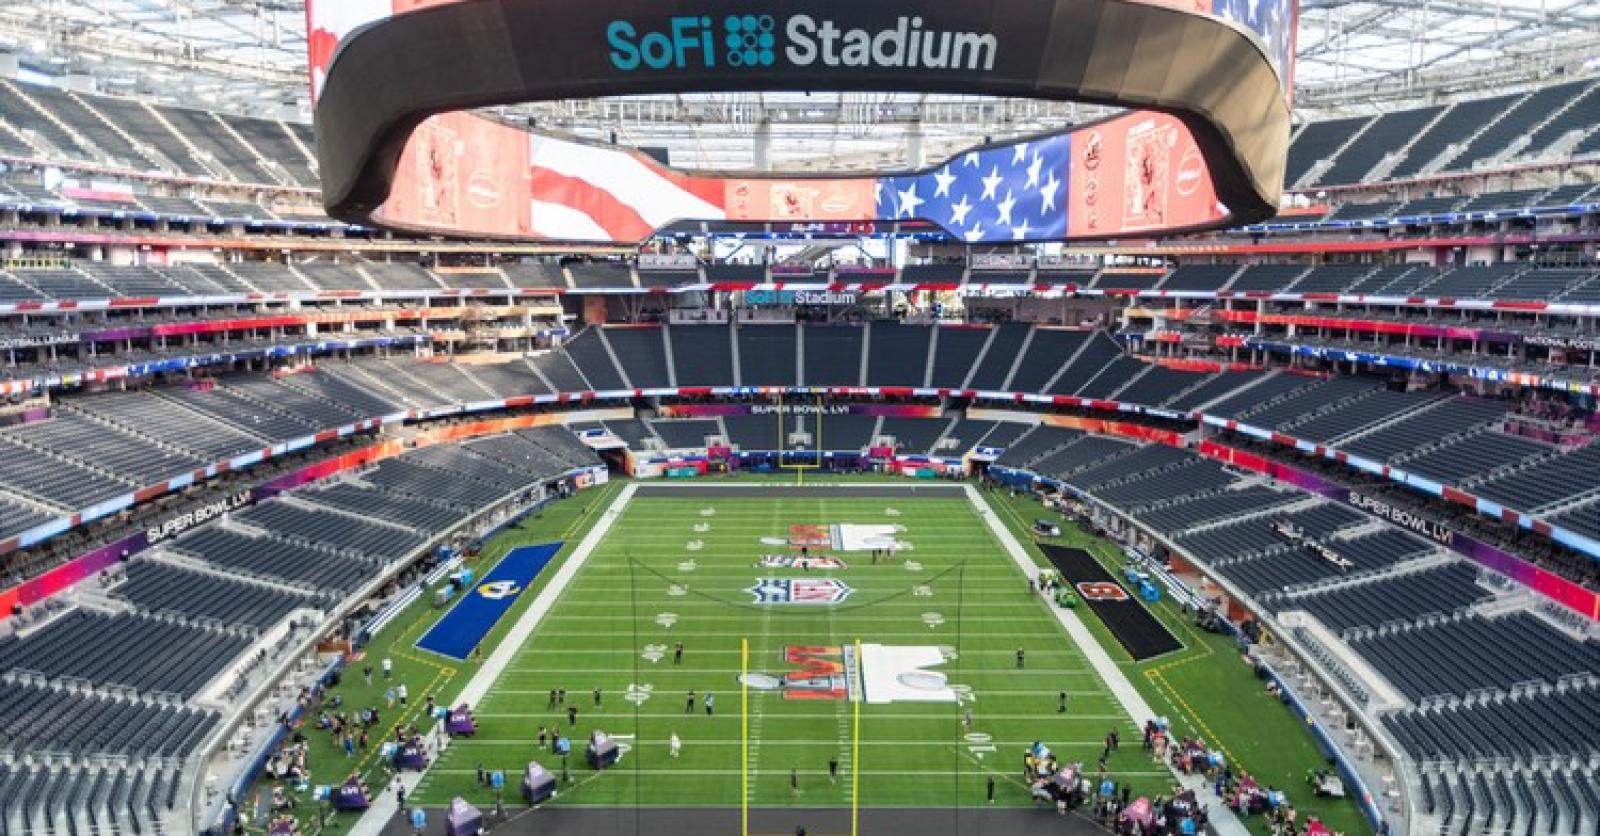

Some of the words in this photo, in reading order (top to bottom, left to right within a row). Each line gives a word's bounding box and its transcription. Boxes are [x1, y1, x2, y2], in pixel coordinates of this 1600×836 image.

[607, 16, 715, 70] SoFi
[785, 14, 998, 71] Stadium
[795, 289, 855, 304] Stadium
[752, 405, 790, 414] SUPER
[793, 405, 828, 414] BOWL
[831, 405, 850, 414] LVI
[147, 513, 192, 543] SUPER
[195, 498, 231, 523] BOWL
[232, 490, 250, 507] LVI
[1350, 491, 1390, 518] SUPER
[1393, 507, 1430, 535] BOWL
[1433, 523, 1453, 544] LVI
